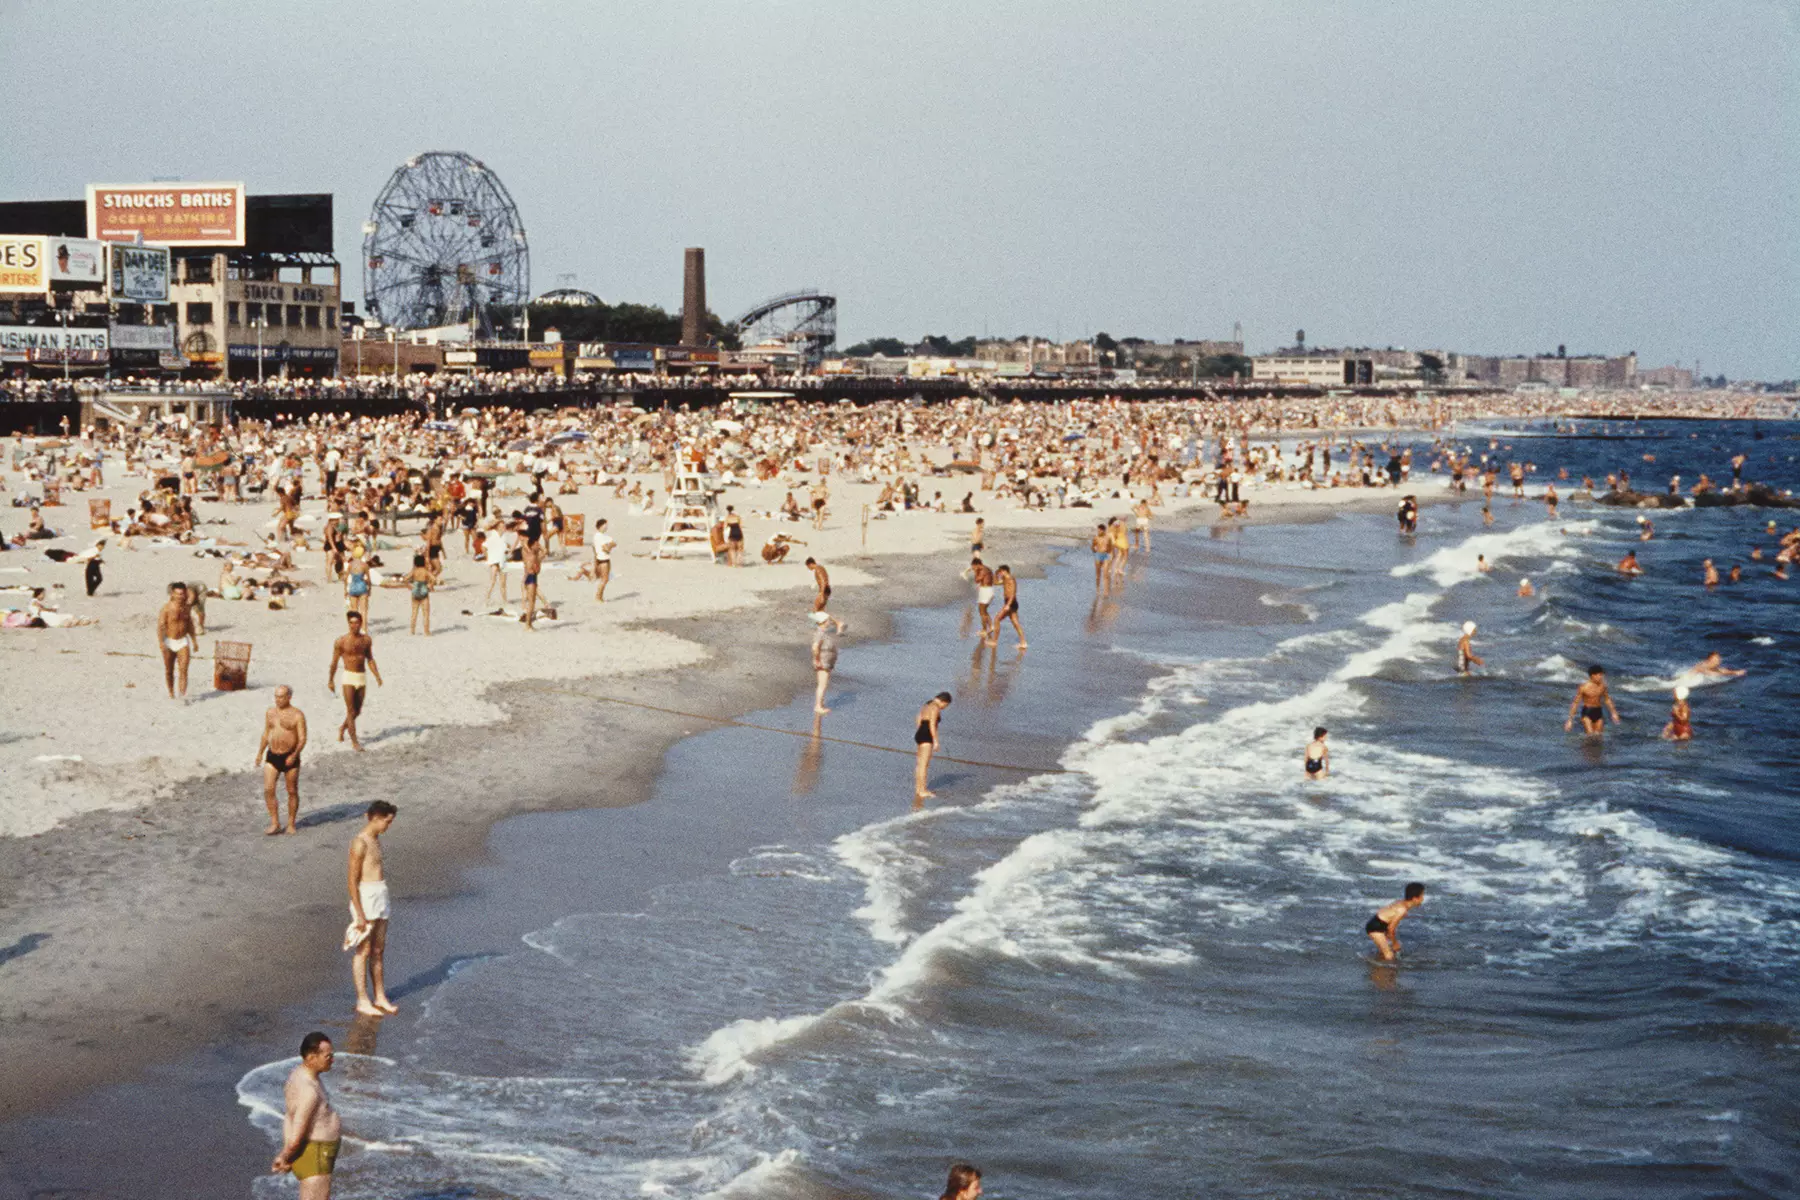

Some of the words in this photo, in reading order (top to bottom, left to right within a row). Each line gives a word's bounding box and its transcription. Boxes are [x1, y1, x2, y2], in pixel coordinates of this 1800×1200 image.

[104, 193, 175, 208] STAUCHS
[180, 192, 233, 208] BATHS
[106, 213, 157, 225] OCEAN
[163, 211, 226, 224] BATHING
[0, 243, 37, 268] E'S
[0, 273, 38, 286] RTERS
[244, 284, 284, 300] STAUCH
[292, 287, 324, 303] BATHS
[65, 333, 105, 349] BATHS
